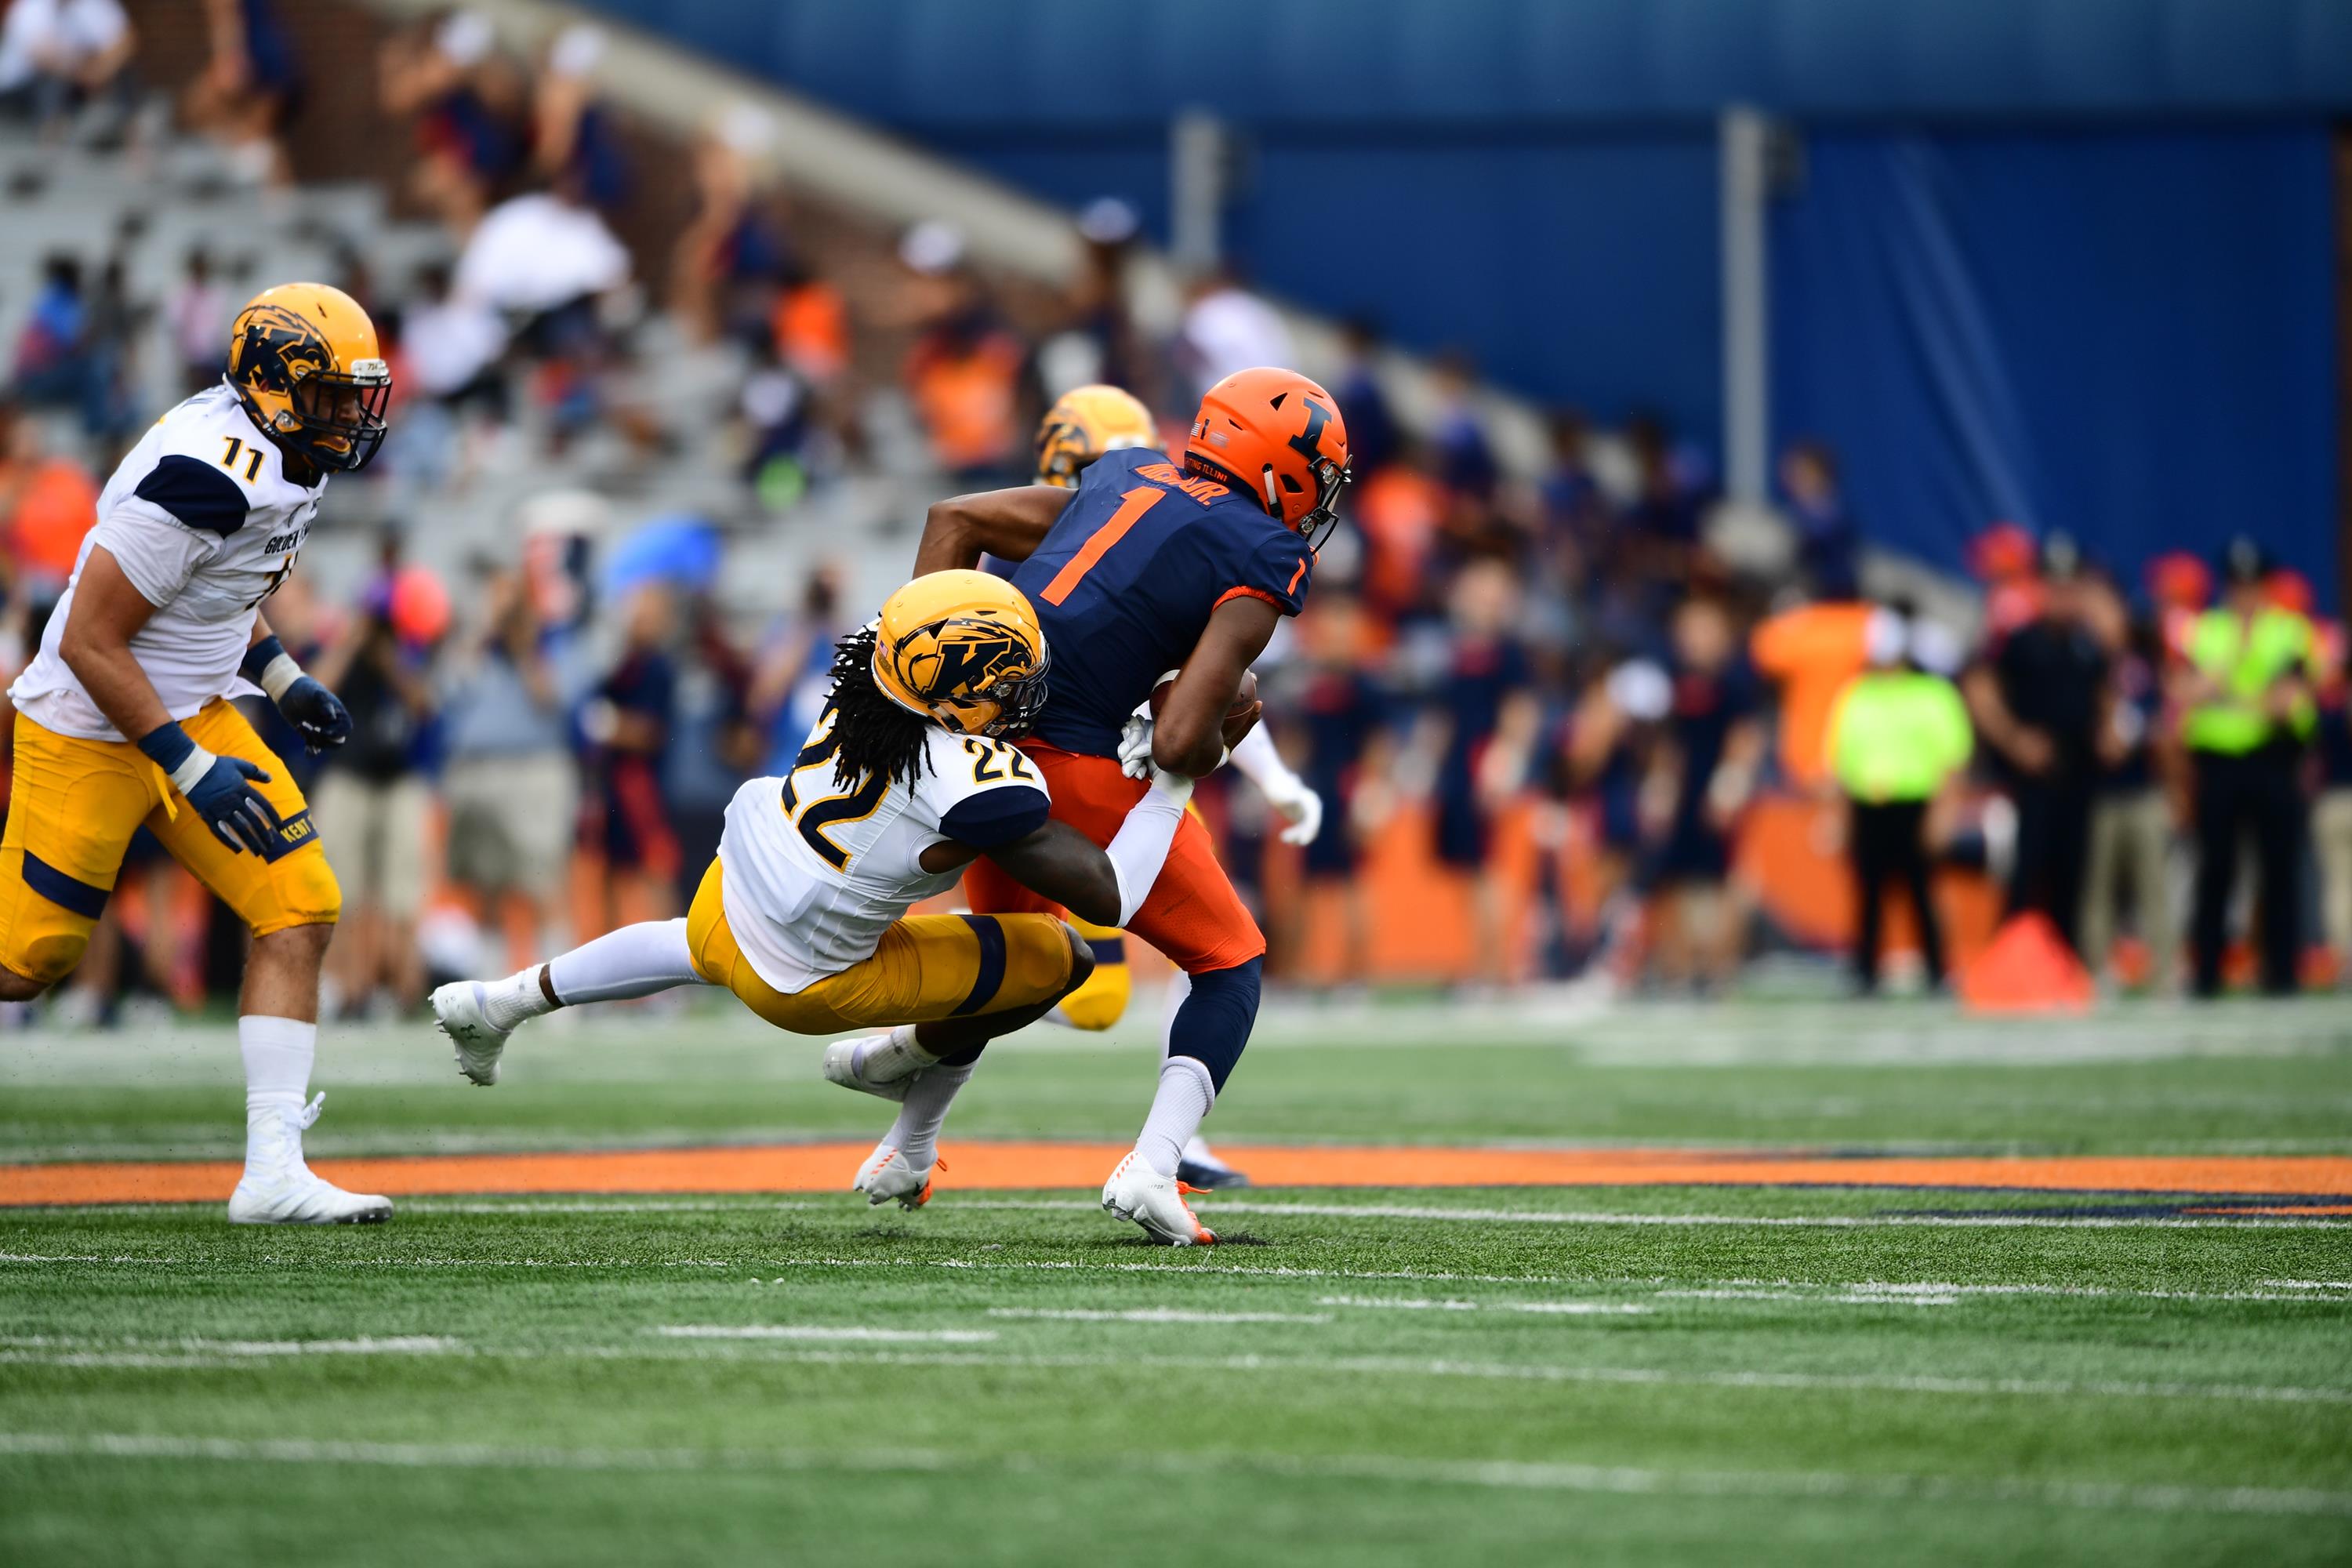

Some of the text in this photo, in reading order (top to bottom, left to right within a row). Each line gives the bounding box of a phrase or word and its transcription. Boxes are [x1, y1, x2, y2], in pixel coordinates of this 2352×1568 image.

[221, 435, 266, 485] 11
[1203, 464, 1228, 482] ILLINI
[1040, 486, 1167, 607] 1
[1287, 557, 1306, 597] 1
[780, 694, 891, 874] 22
[963, 737, 1036, 786] 22
[280, 818, 311, 843] KENT
